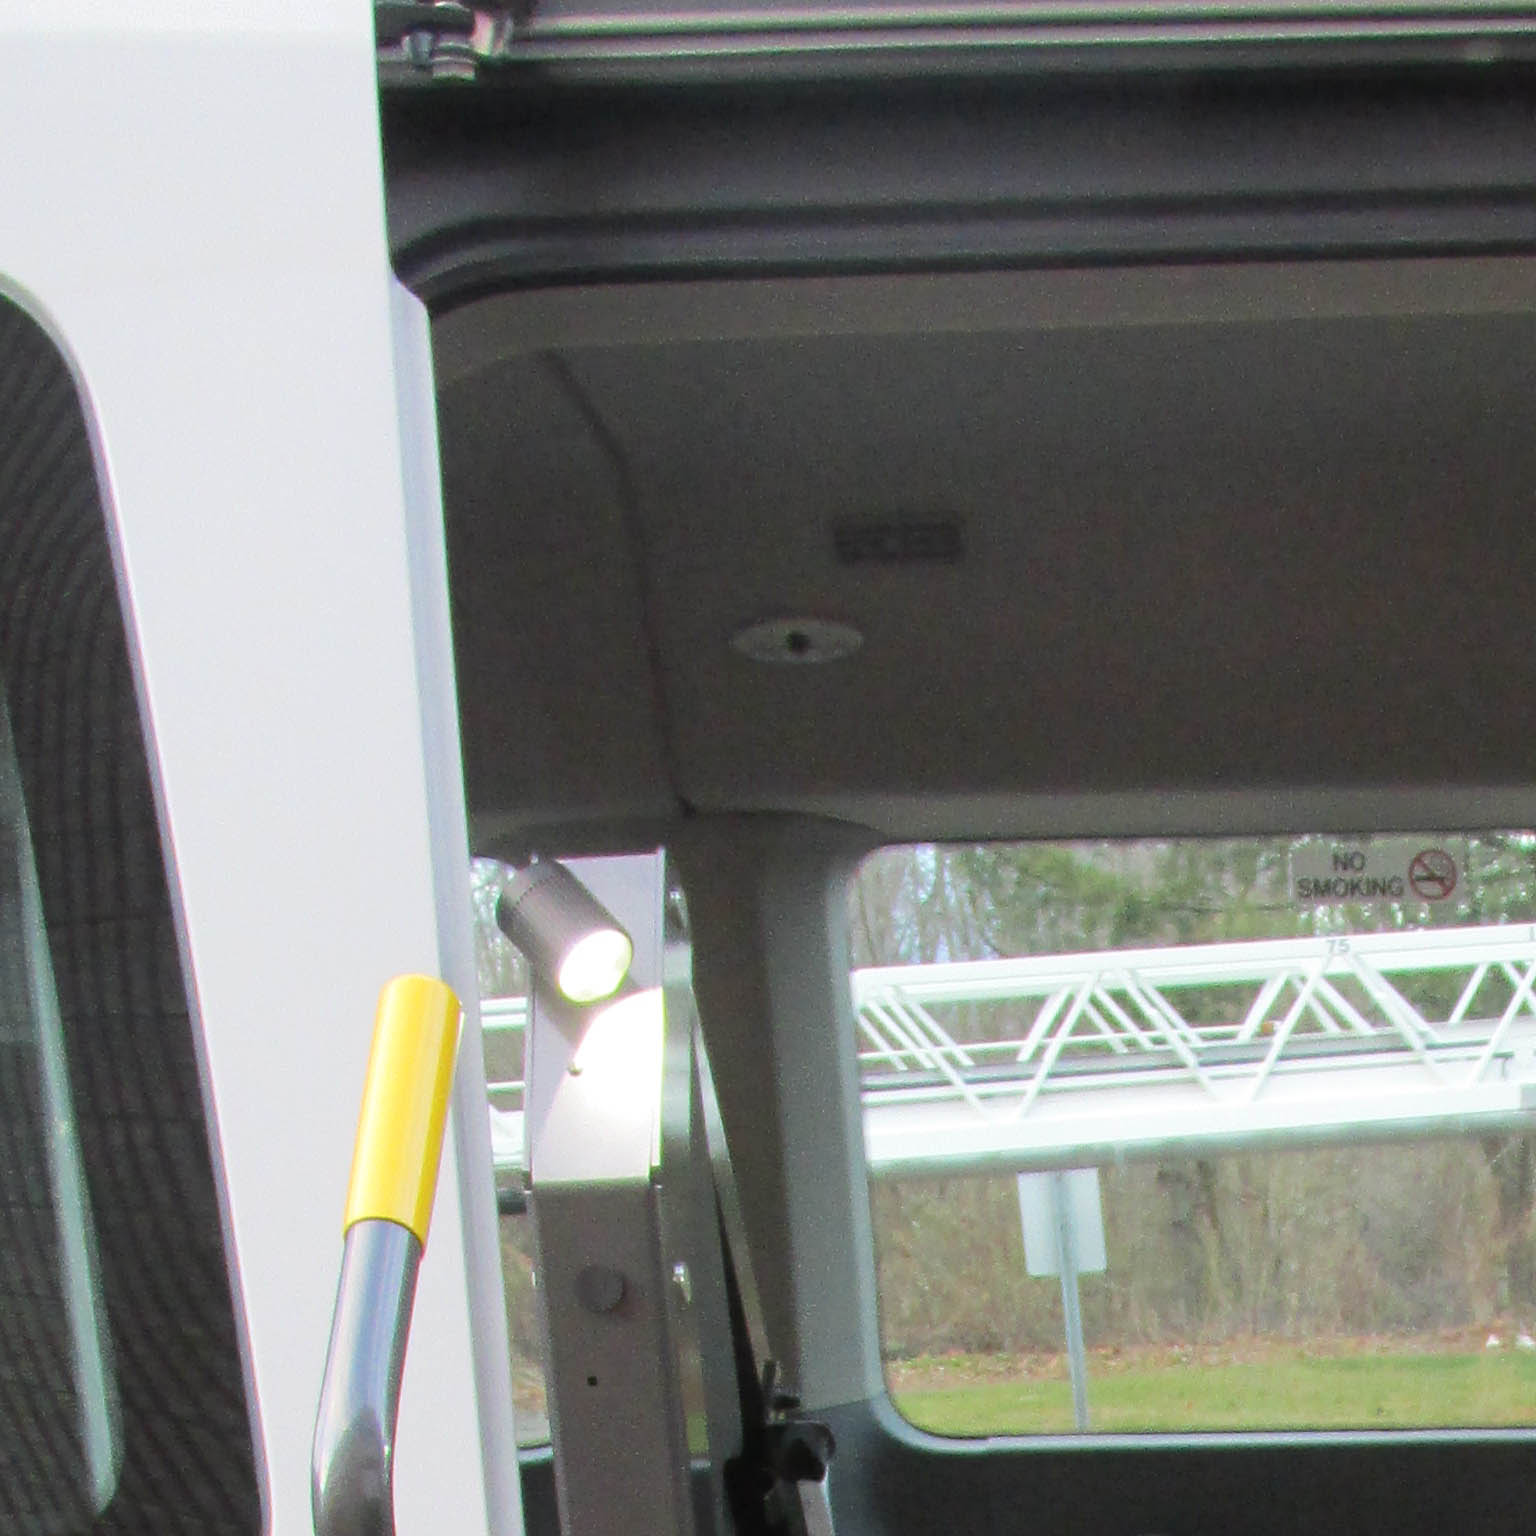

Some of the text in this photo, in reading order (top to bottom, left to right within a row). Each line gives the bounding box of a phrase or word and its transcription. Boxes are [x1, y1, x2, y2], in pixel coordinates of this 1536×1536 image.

[1332, 850, 1367, 871] NO
[1297, 875, 1405, 898] SMOKING
[1325, 938, 1351, 954] 75
